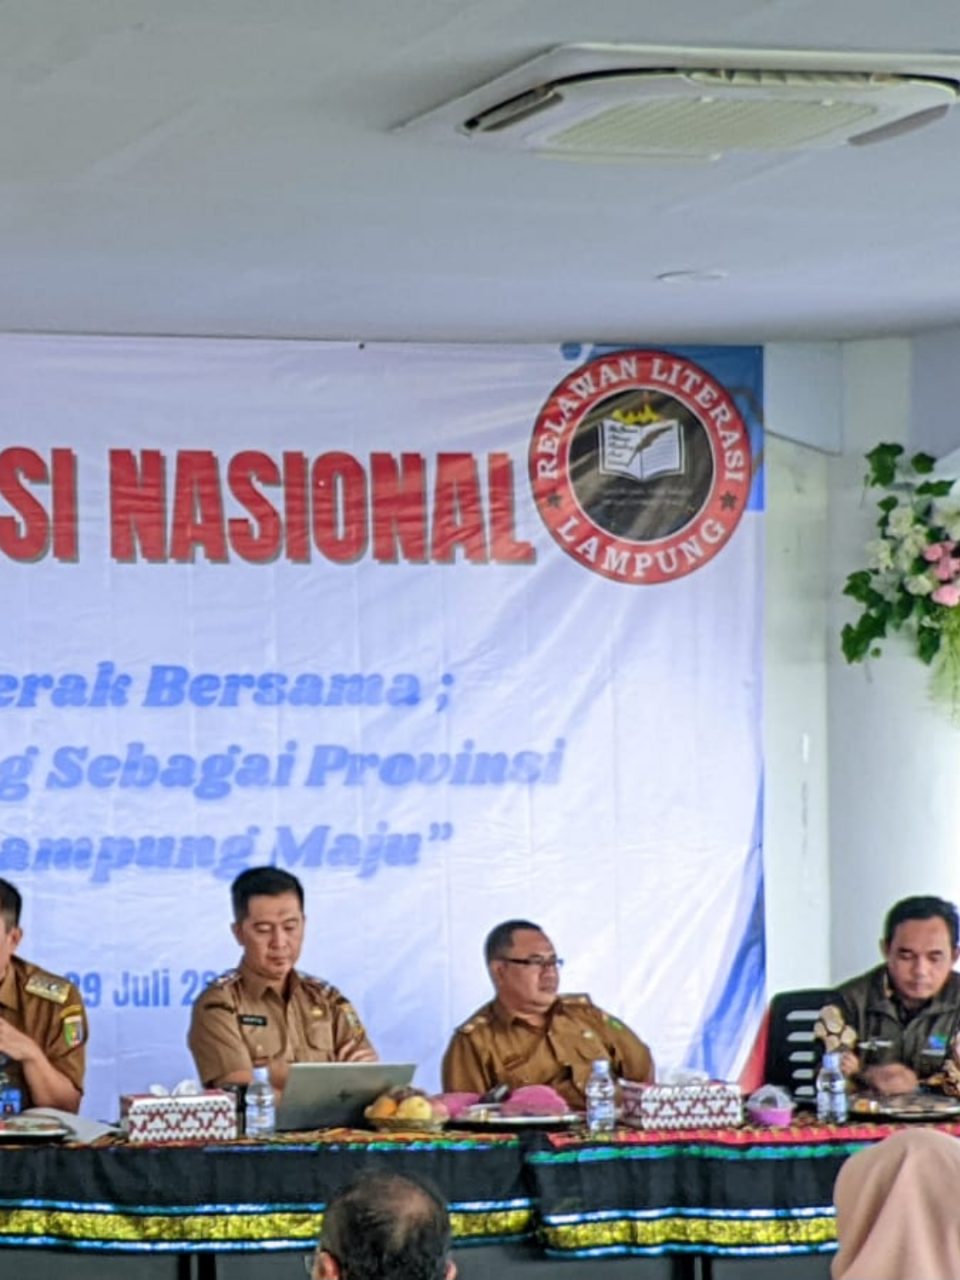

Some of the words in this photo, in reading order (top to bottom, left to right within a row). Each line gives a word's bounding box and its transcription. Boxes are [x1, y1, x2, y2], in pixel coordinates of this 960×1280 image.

[537, 357, 638, 479] RELAWAN
[651, 358, 744, 482] LITERASI
[109, 448, 536, 565] NASIONAL
[558, 518, 725, 577] LAMPUNG
[47, 741, 296, 800] Sebagai
[304, 739, 566, 788] Provinsi
[113, 968, 170, 1007] Juli
